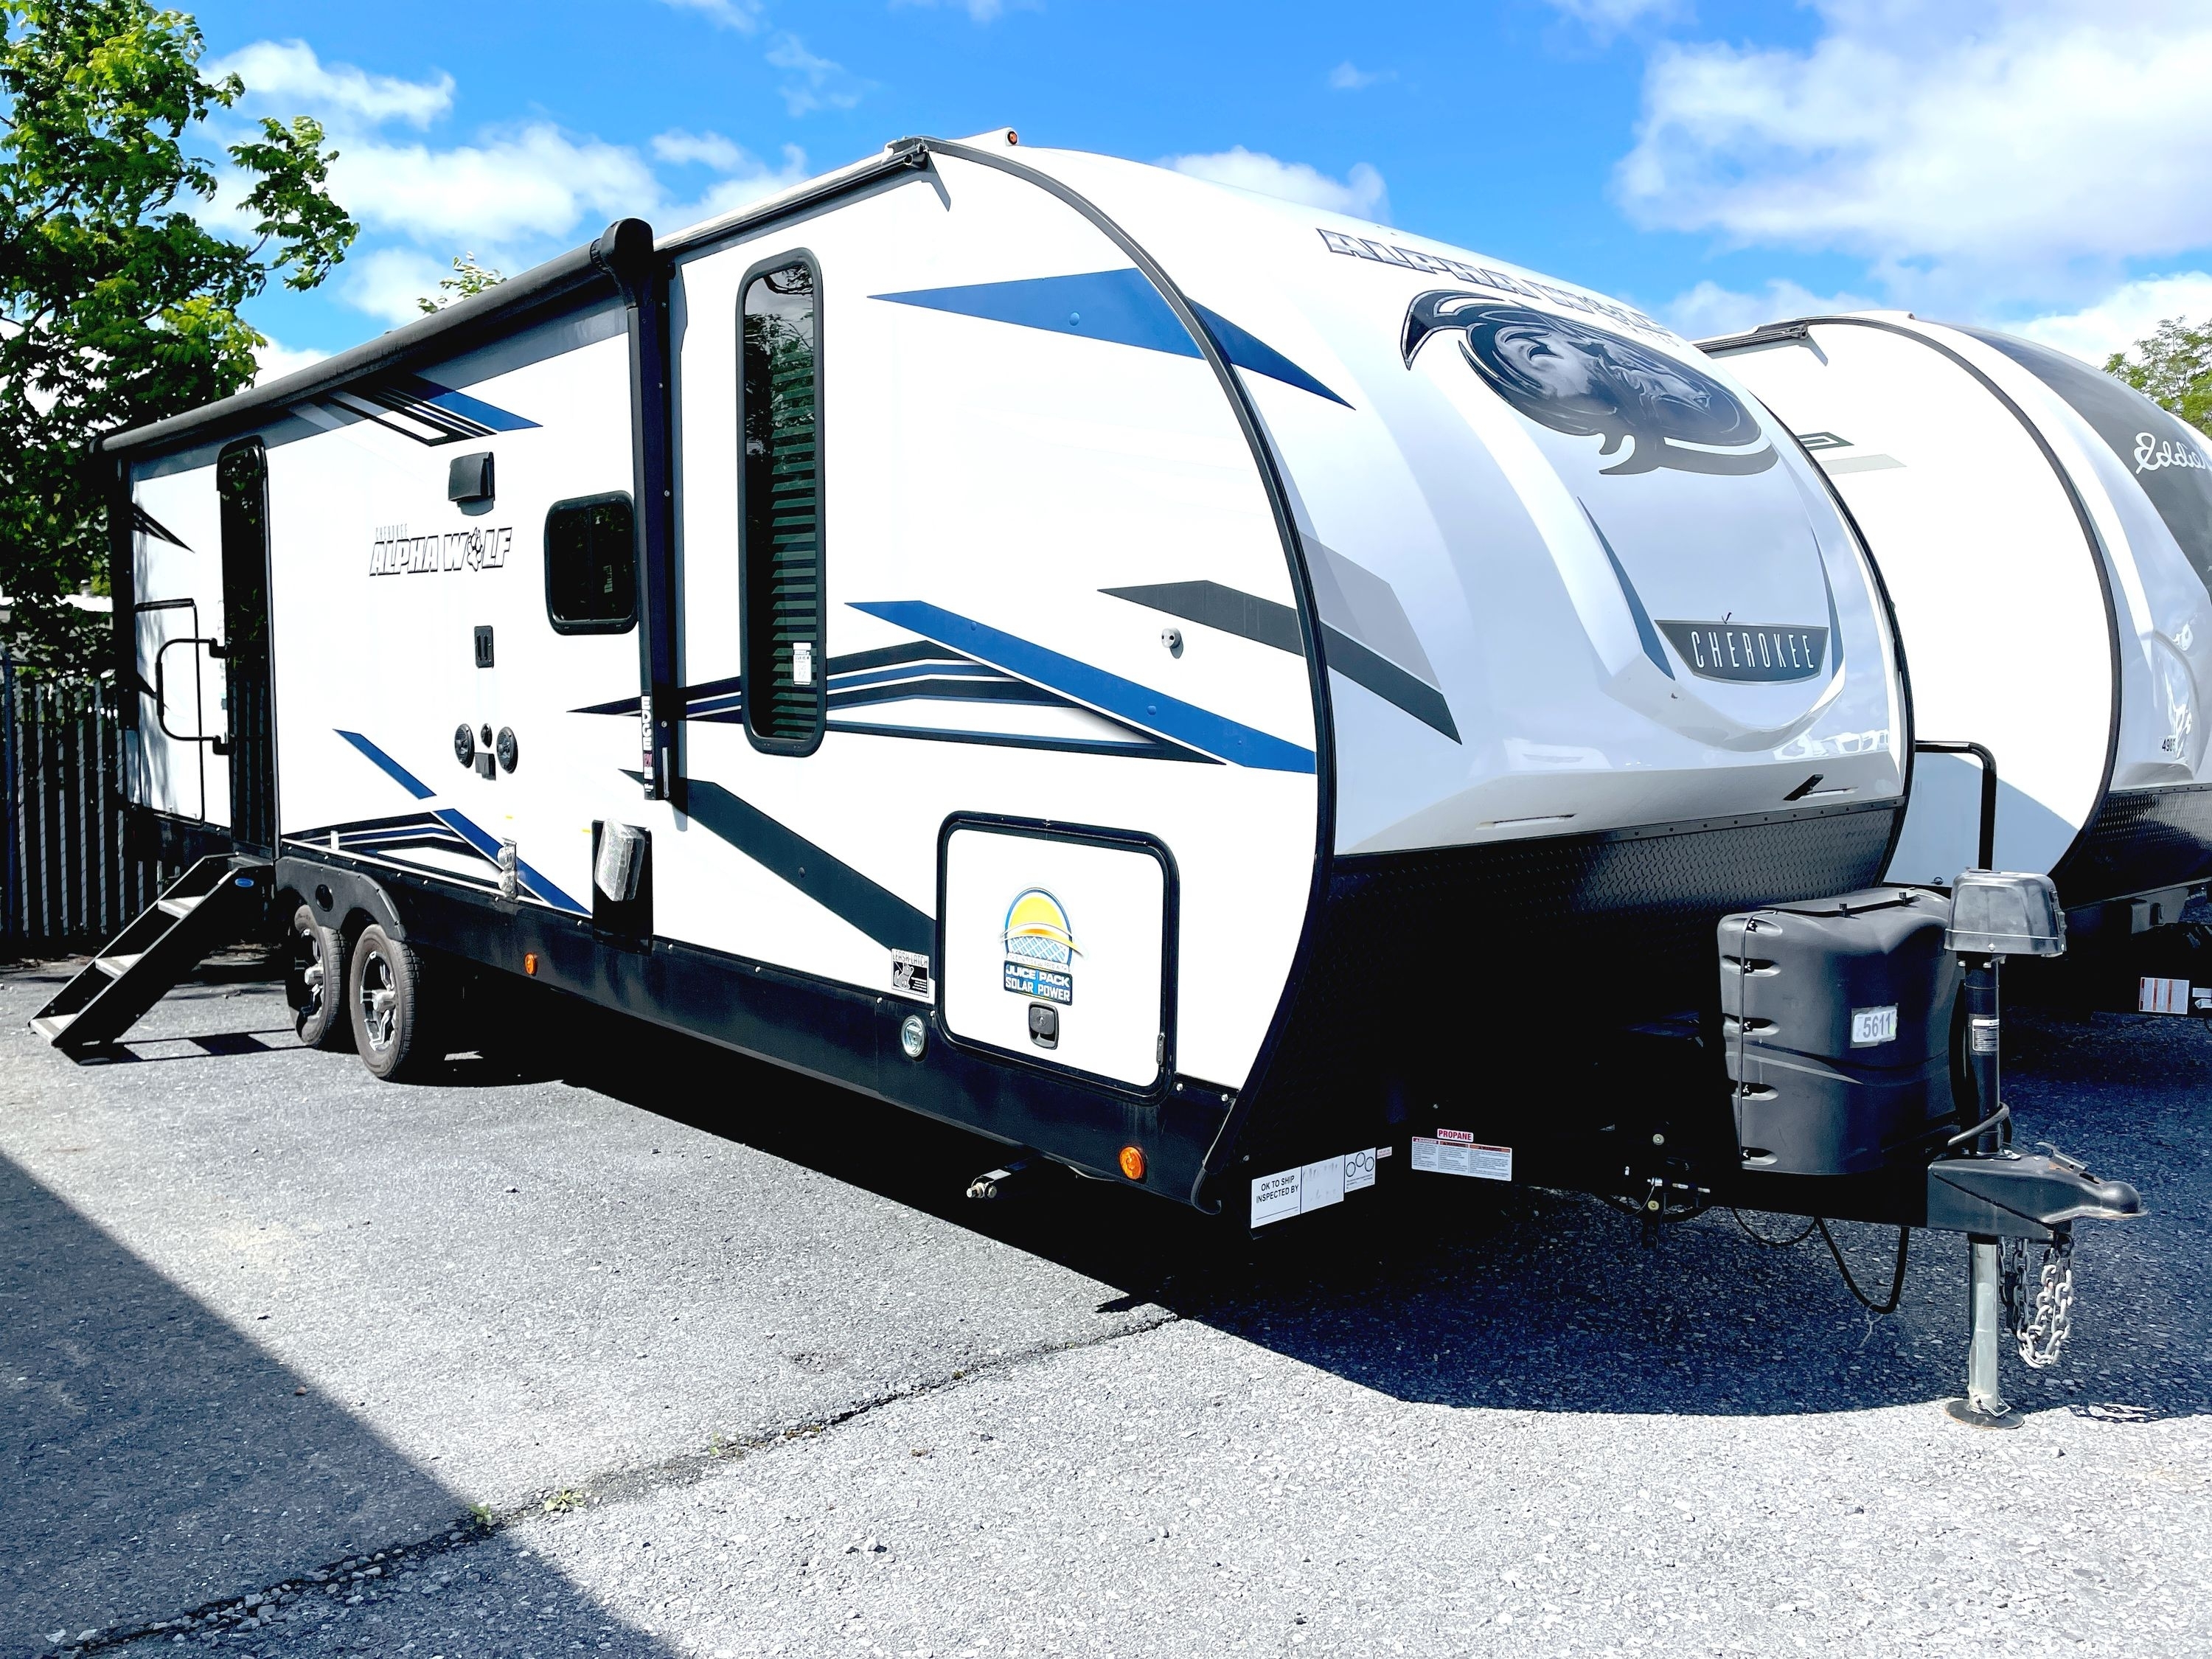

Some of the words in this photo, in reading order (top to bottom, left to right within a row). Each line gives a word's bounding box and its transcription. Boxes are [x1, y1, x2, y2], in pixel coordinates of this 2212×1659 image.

[1316, 228, 1541, 300] ALPHA
[369, 535, 438, 577] ALPHA
[1691, 630, 1814, 669] CHEROKEE
[641, 695, 652, 751] EDGE
[1005, 964, 1036, 981] JUICE
[1039, 971, 1070, 988] PACK
[1005, 976, 1034, 993] SOLAR
[1037, 983, 1070, 1002] POWER
[1863, 1012, 1891, 1038] 5611
[1439, 1130, 1472, 1141] PROPANE
[1256, 1186, 1290, 1203] INSPECTED
[1290, 1183, 1299, 1194] BY
[1261, 1181, 1270, 1192] OK
[1272, 1178, 1280, 1188] TO
[1281, 1175, 1295, 1185] SHIP
